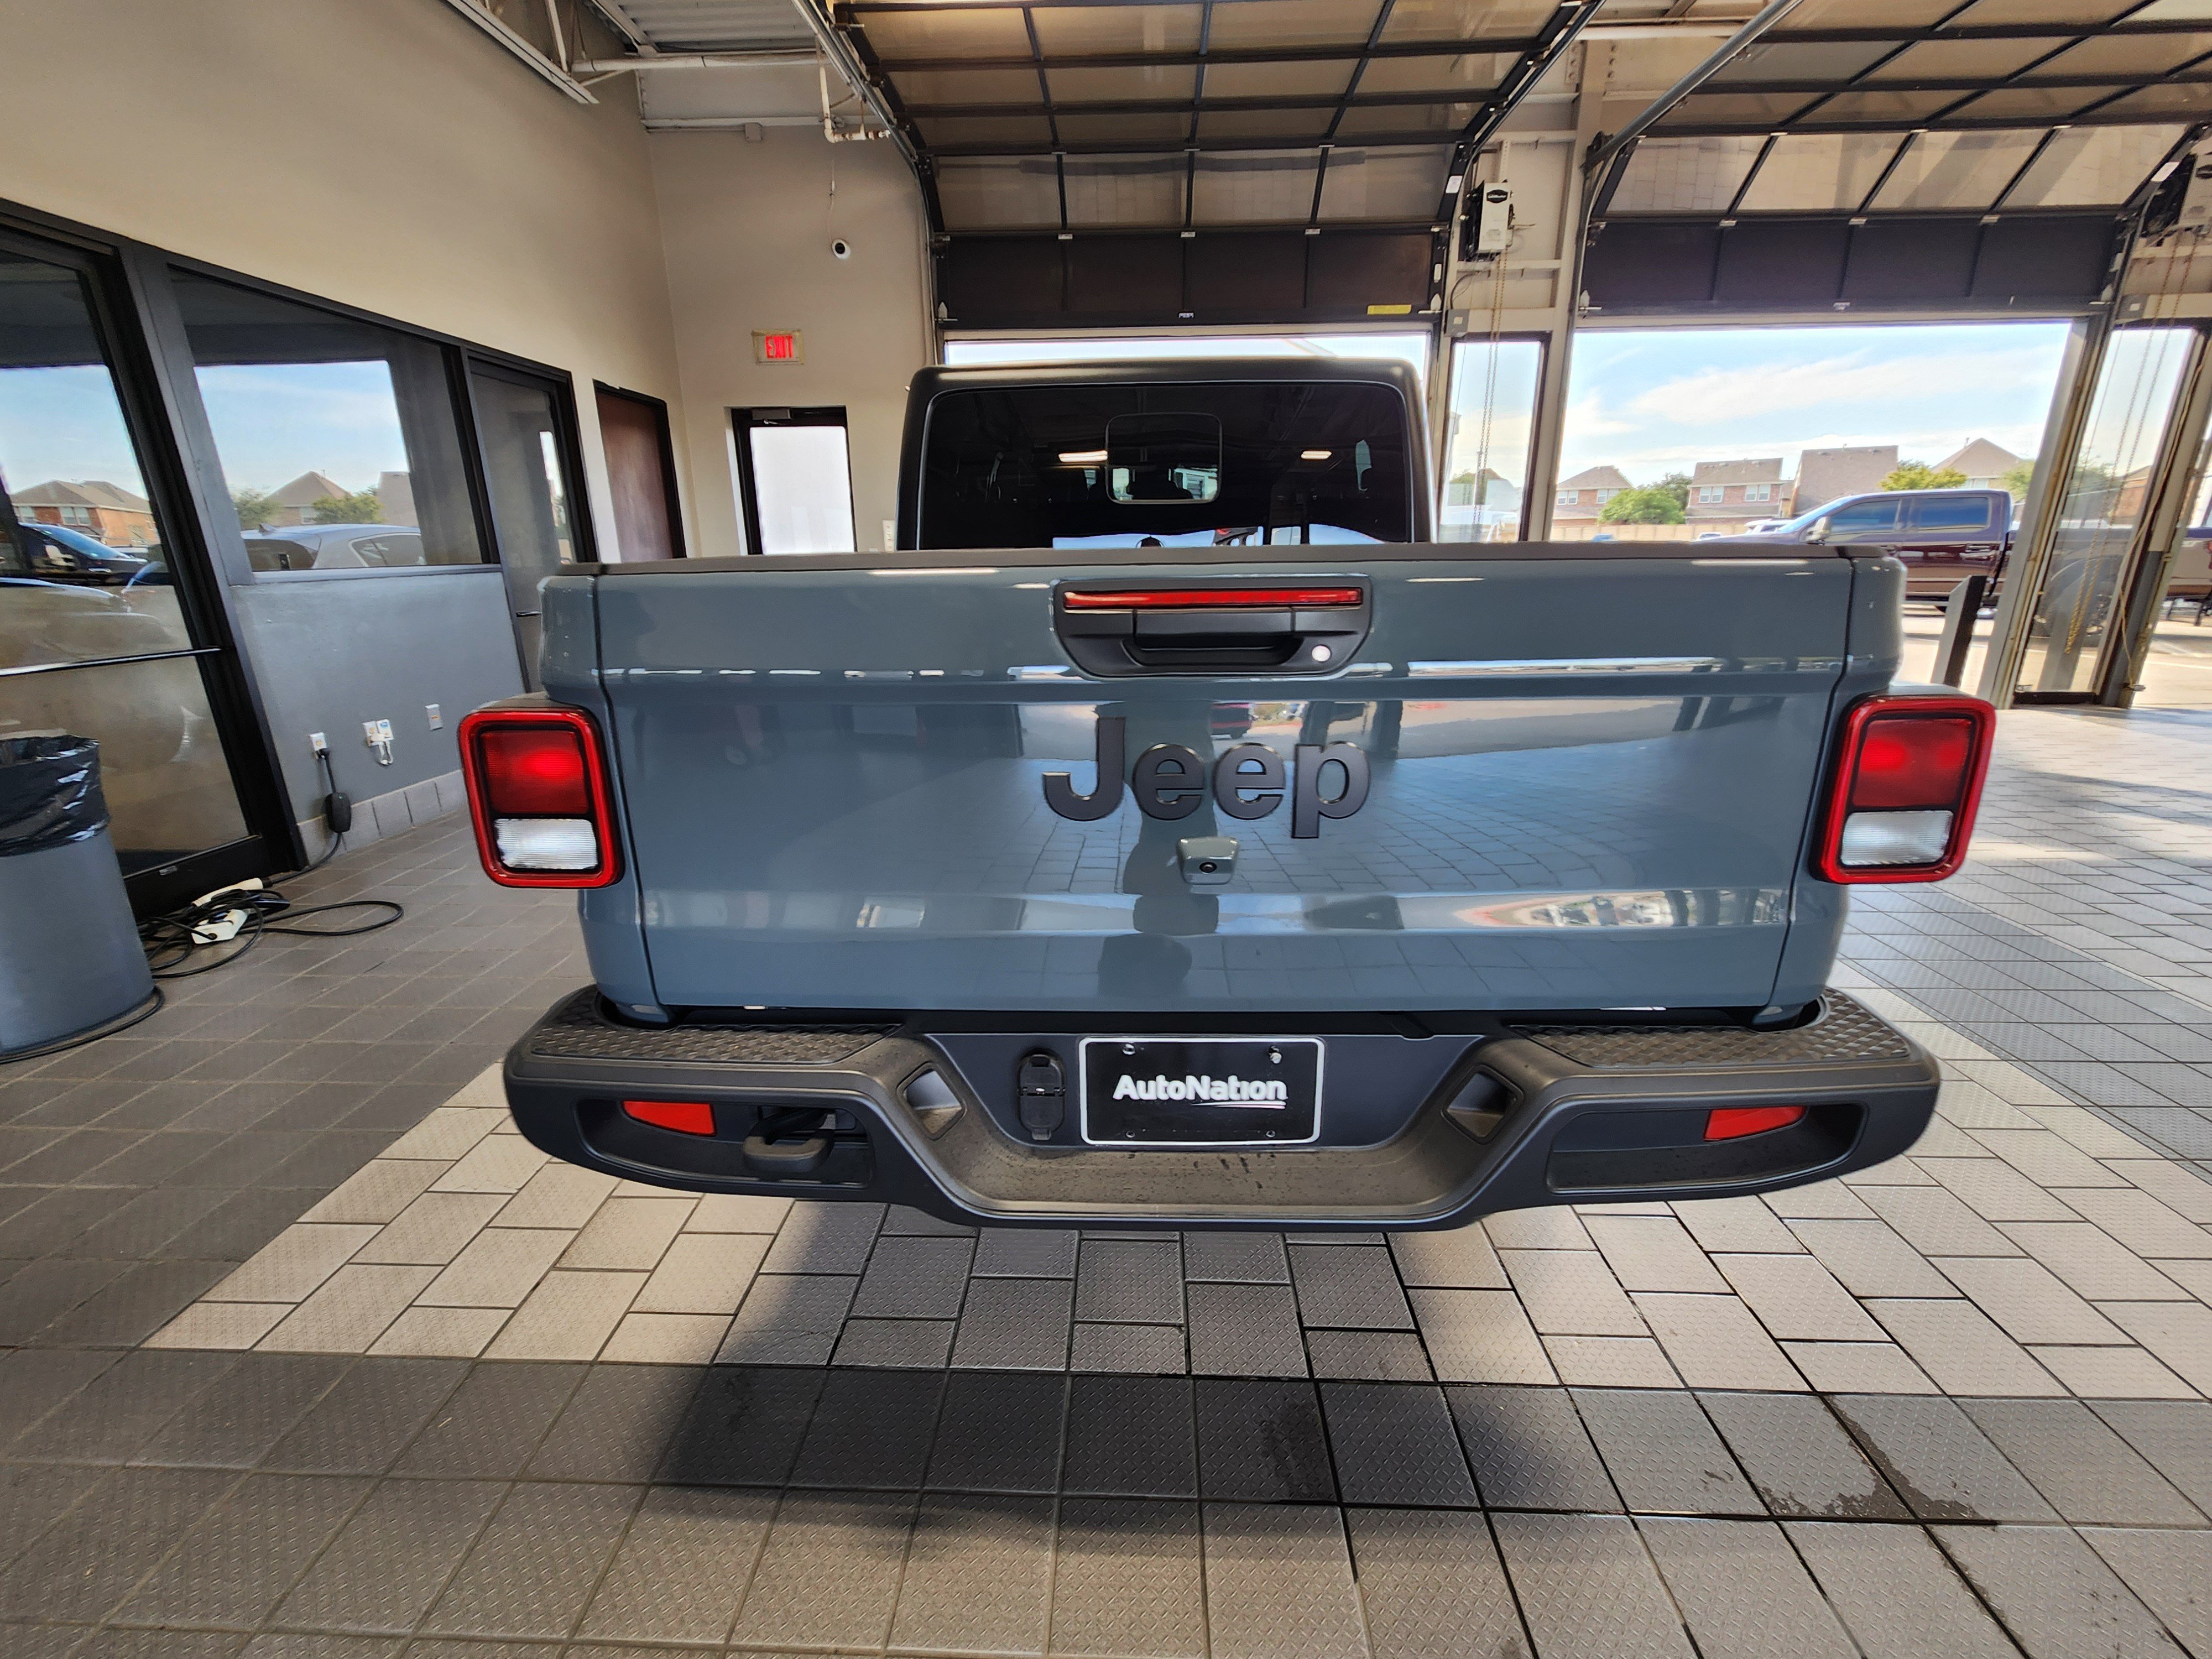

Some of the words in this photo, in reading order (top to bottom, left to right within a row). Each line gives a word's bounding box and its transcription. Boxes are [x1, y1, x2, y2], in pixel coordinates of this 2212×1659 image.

[765, 335, 792, 358] EXIT
[1042, 716, 1370, 839] Jeep
[1113, 1074, 1288, 1100] AutoNation
